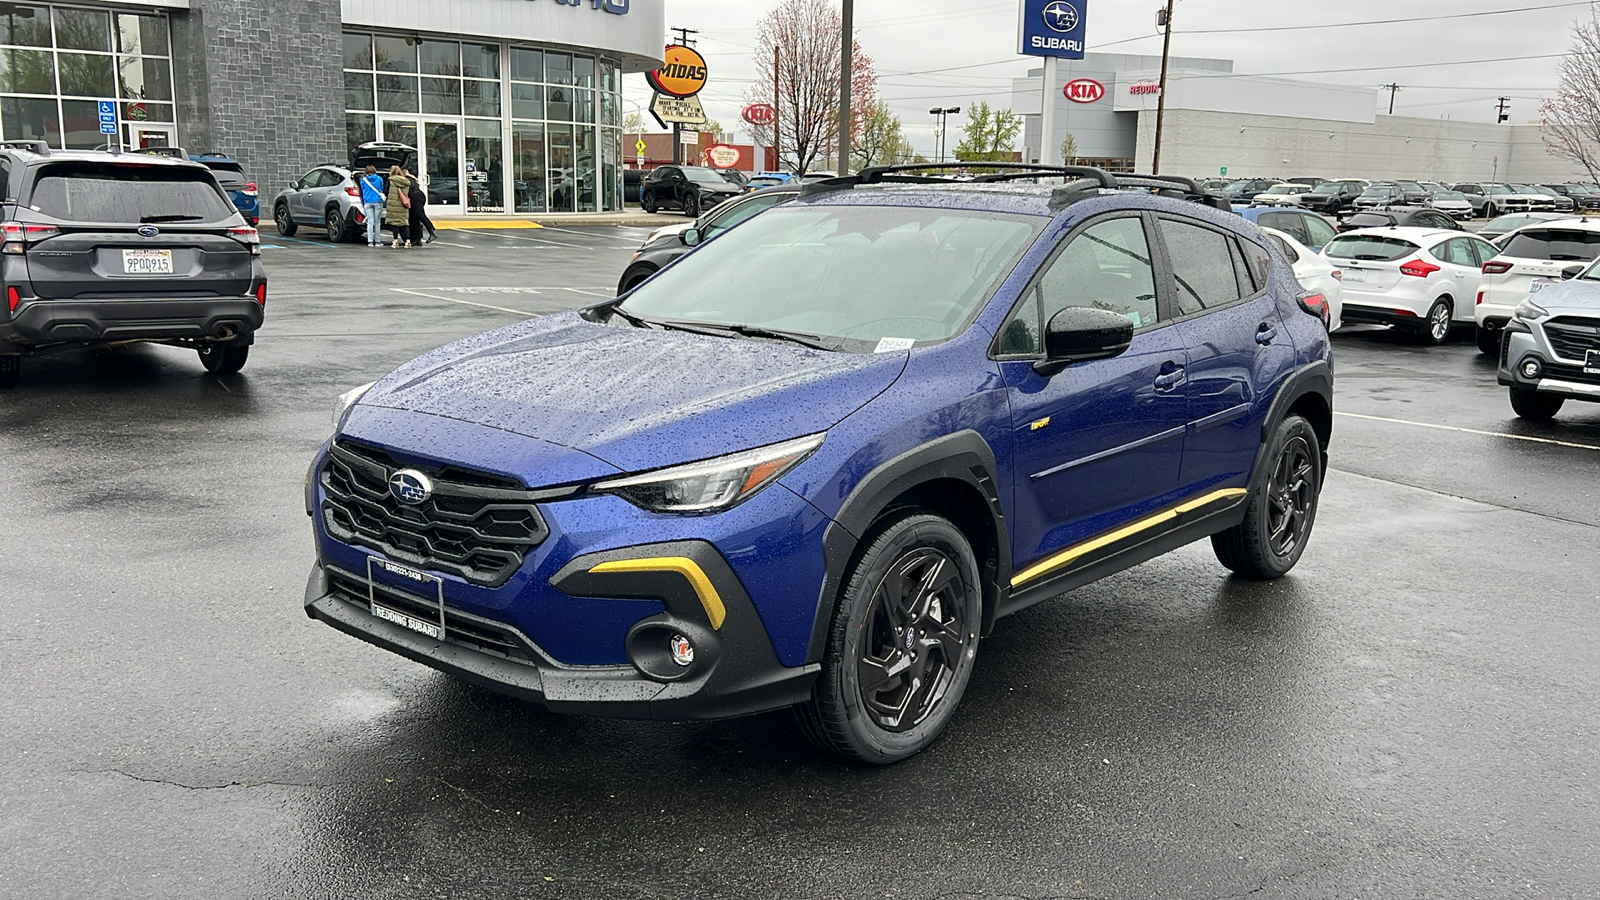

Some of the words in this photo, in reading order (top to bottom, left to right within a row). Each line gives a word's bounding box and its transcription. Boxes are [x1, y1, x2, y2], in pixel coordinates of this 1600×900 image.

[1031, 36, 1083, 52] SUBARU
[658, 63, 706, 80] MIDAS
[1071, 84, 1098, 98] KIA
[1129, 84, 1158, 95] REDDIN
[751, 107, 772, 122] KIA
[376, 606, 407, 627] REDDING
[408, 618, 438, 638] SUBARU
